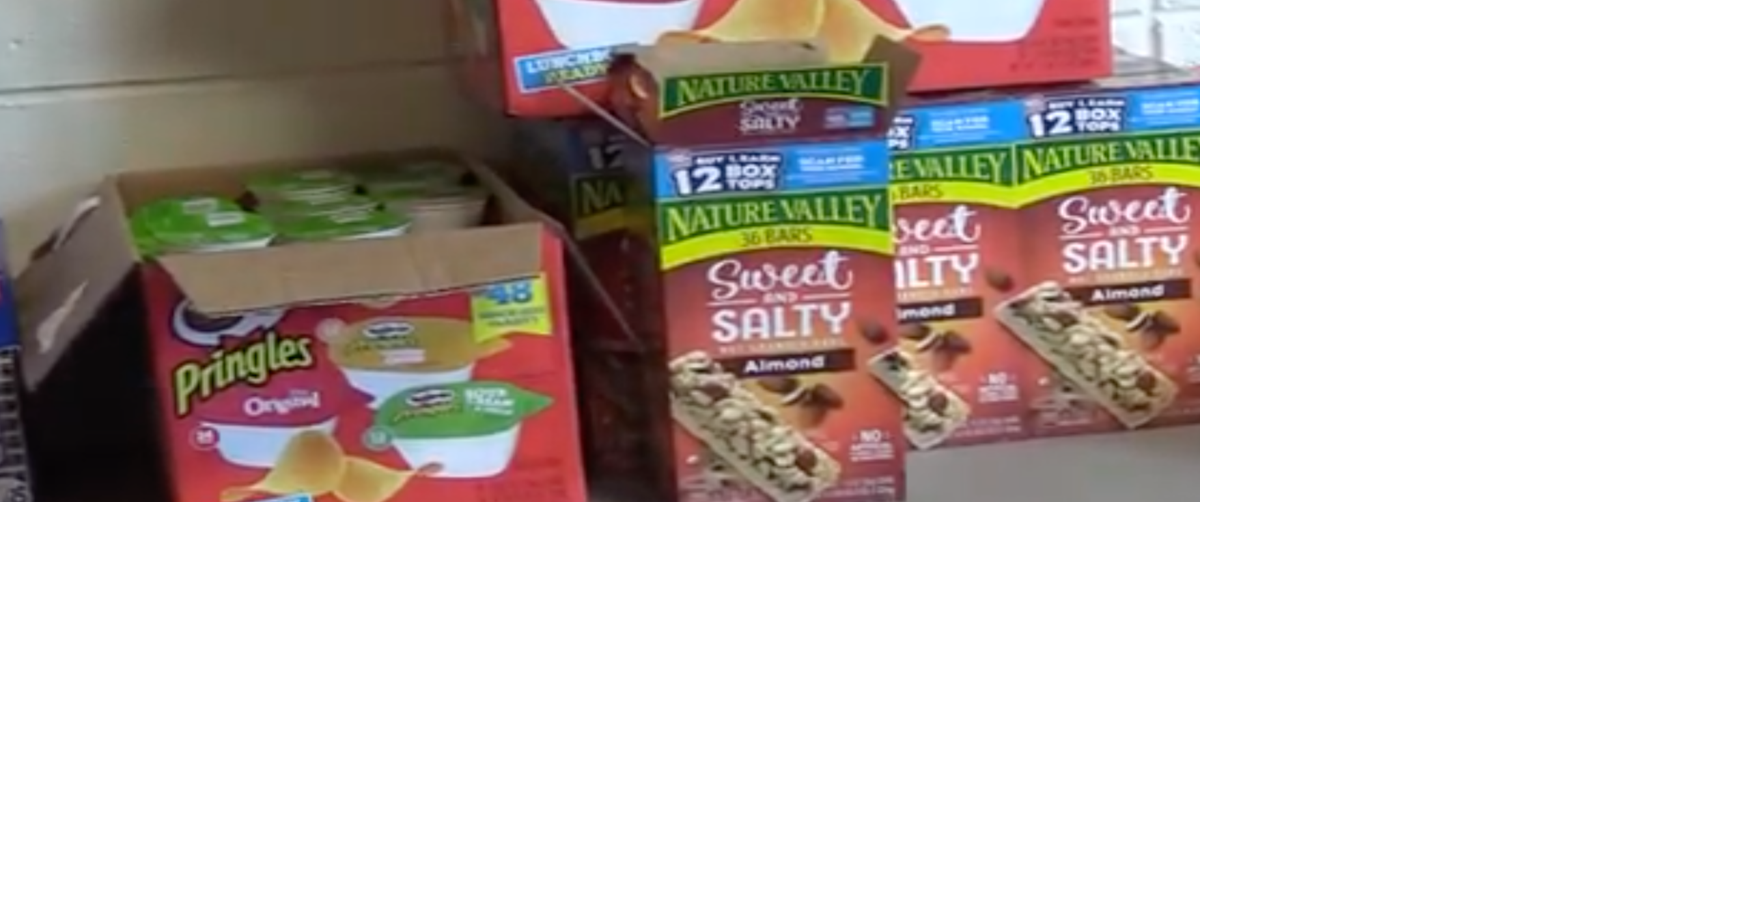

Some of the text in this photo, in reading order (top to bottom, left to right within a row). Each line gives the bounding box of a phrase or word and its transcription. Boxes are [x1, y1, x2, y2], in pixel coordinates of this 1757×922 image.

[676, 68, 869, 106] NATURE VALLEY
[738, 115, 800, 133] SALTY
[1030, 109, 1073, 137] 12
[1074, 107, 1121, 121] BOX
[1076, 120, 1120, 132] TOPS
[587, 147, 624, 170] 12
[914, 152, 1007, 183] VALLEY
[1023, 136, 1199, 182] NATURE VALLE
[675, 166, 722, 195] 12
[725, 163, 777, 179] BOX
[1111, 165, 1154, 180] BARS
[727, 178, 775, 190] TOPS
[900, 185, 943, 199] BARS
[667, 194, 882, 241] NATURE VALLEY
[1058, 187, 1191, 234] Sweet
[893, 205, 981, 244] eet
[1109, 226, 1140, 236] AND
[740, 227, 813, 246] 36 BARS
[1062, 235, 1189, 273] SALTY
[707, 250, 853, 300] Sweet
[894, 252, 979, 290] LTY
[762, 292, 798, 303] AND
[1092, 285, 1165, 301] Almond
[711, 302, 850, 342] SALTY
[897, 304, 956, 321] lmond
[174, 330, 313, 416] Pringles
[743, 355, 826, 374] Almond
[243, 391, 322, 417] Original
[860, 429, 882, 442] NO
